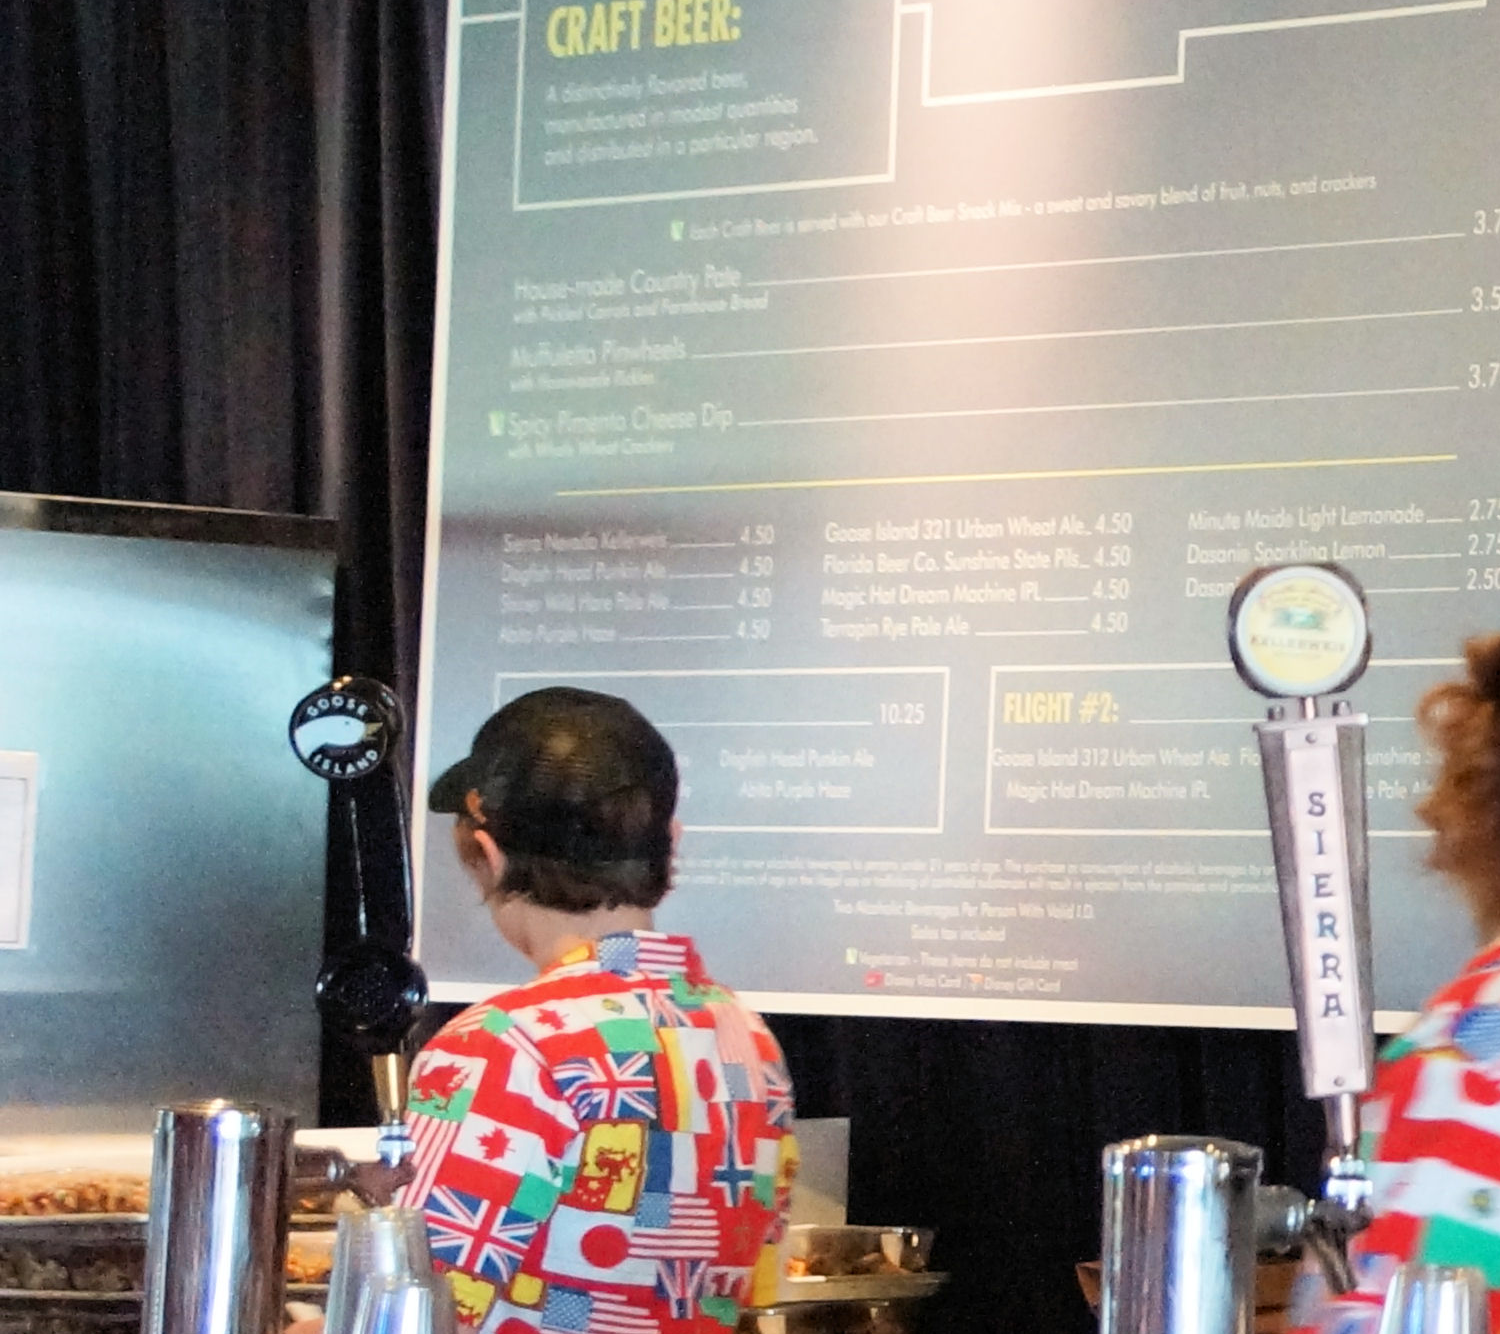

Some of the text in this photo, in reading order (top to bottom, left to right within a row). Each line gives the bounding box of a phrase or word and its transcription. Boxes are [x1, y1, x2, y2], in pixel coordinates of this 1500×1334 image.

[307, 694, 368, 717] GOOSE
[879, 702, 926, 726] 10.25
[1002, 691, 1120, 724] FLIGHT #2:
[313, 749, 378, 775] ISLAND
[1306, 791, 1345, 1018] SIERRA
